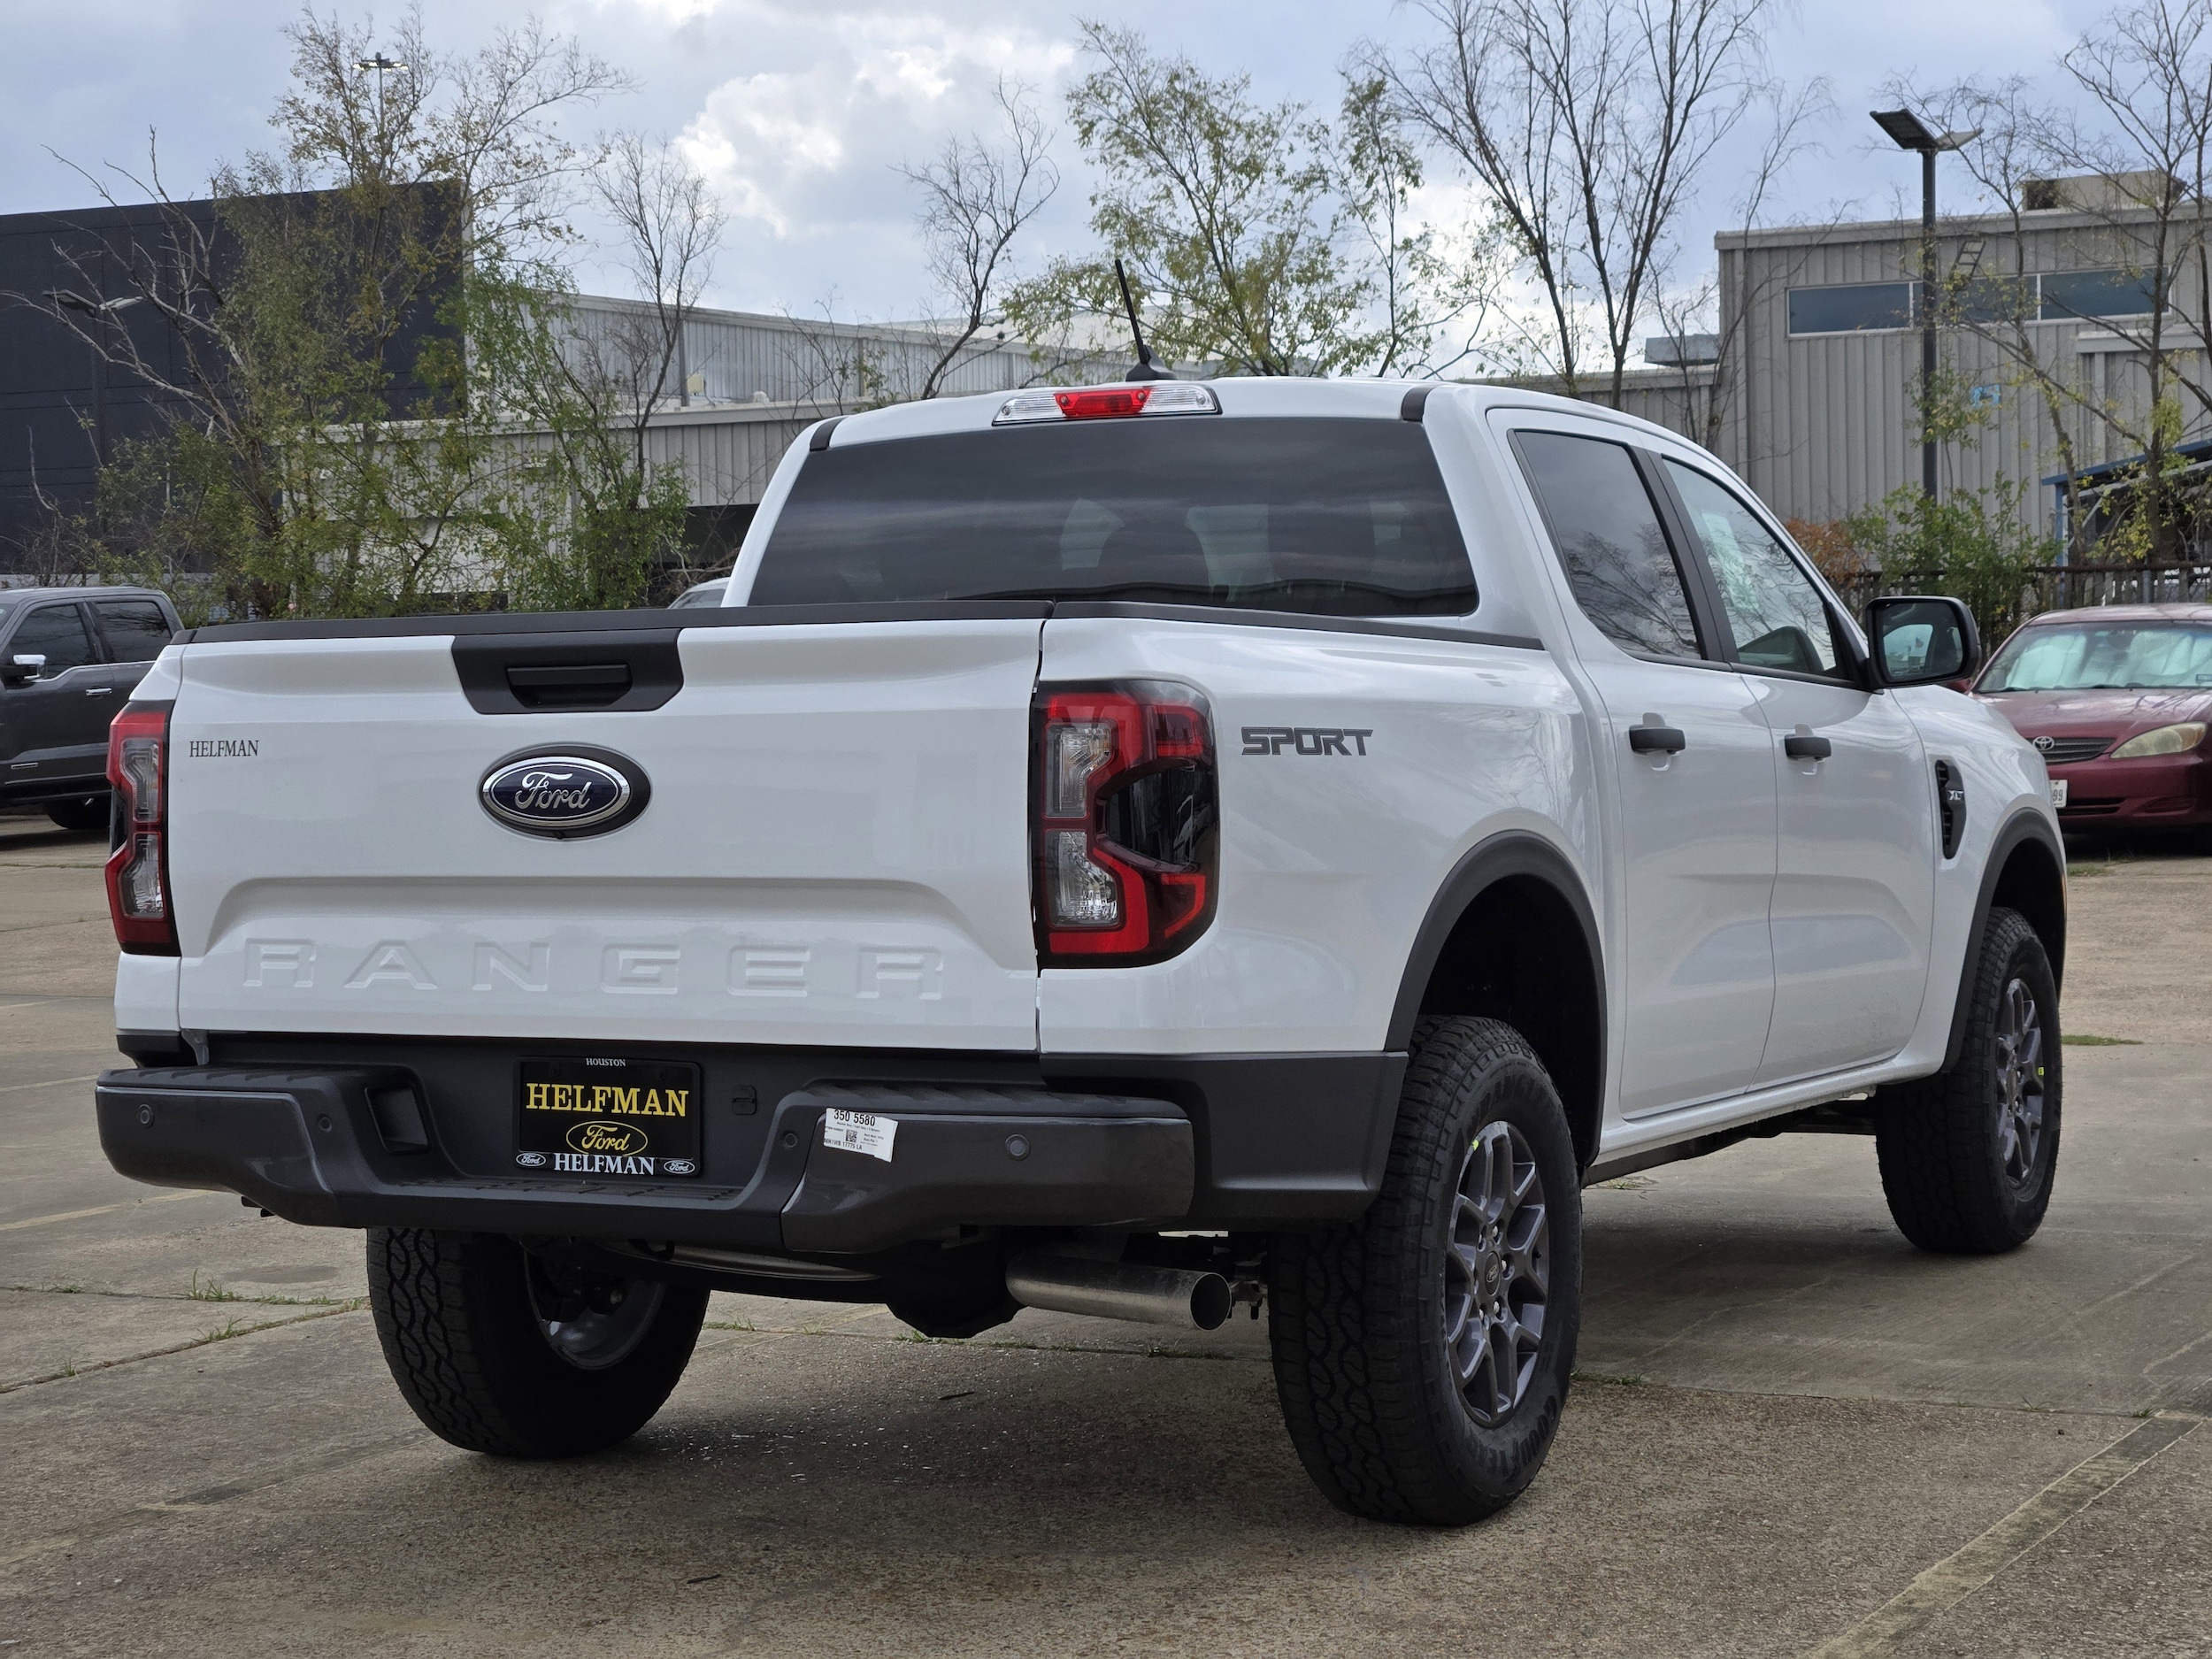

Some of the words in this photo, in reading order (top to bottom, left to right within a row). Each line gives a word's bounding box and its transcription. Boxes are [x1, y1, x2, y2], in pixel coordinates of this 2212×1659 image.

[189, 740, 259, 757] HELFMAN
[1240, 726, 1373, 756] SPORT
[514, 771, 592, 810] Ford
[1947, 790, 1964, 801] XLT
[242, 936, 944, 1001] RANGER
[585, 1057, 626, 1067] HOUSTON
[526, 1082, 689, 1118] HELFMAN
[833, 1109, 850, 1122] 350
[853, 1113, 876, 1126] 5580
[580, 1125, 631, 1151] Ford
[521, 1155, 540, 1164] Ford
[553, 1152, 656, 1175] HELFMAN
[669, 1161, 688, 1171] Ford
